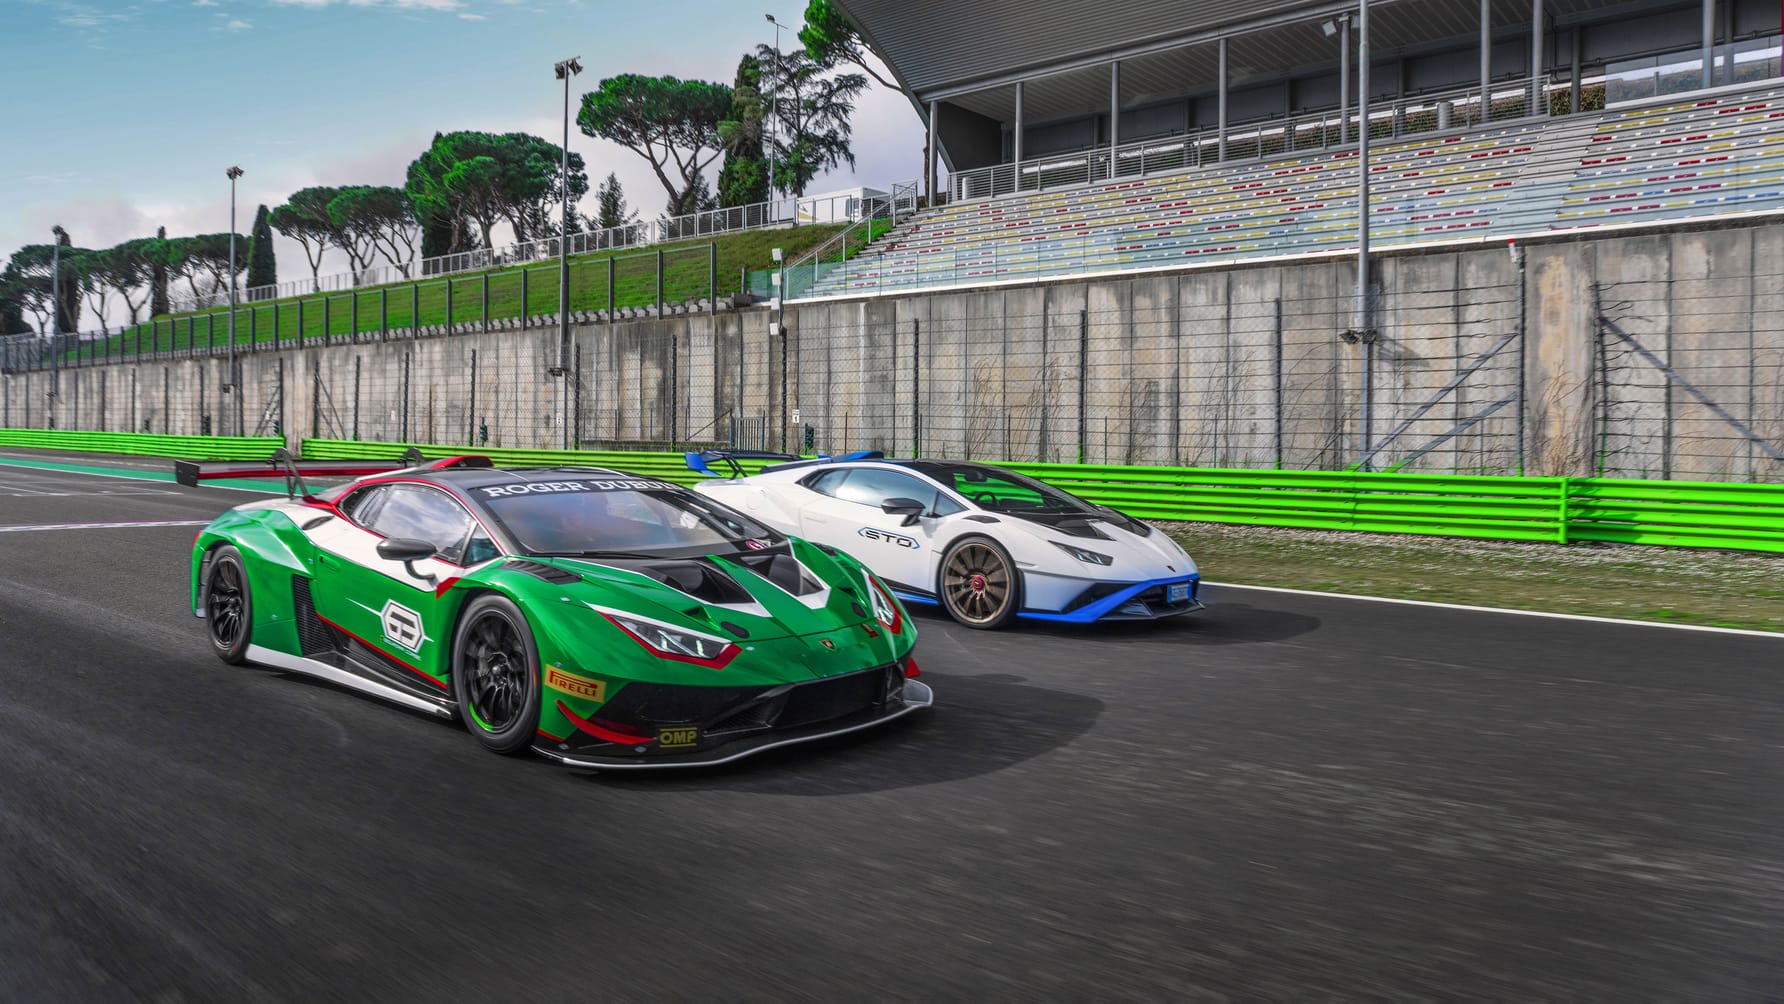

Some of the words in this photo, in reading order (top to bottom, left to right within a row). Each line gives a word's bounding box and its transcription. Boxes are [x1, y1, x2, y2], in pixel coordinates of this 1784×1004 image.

[482, 481, 592, 497] ROGER
[865, 530, 912, 548] STO
[549, 670, 597, 697] PIRELLI
[660, 731, 697, 744] OMP
